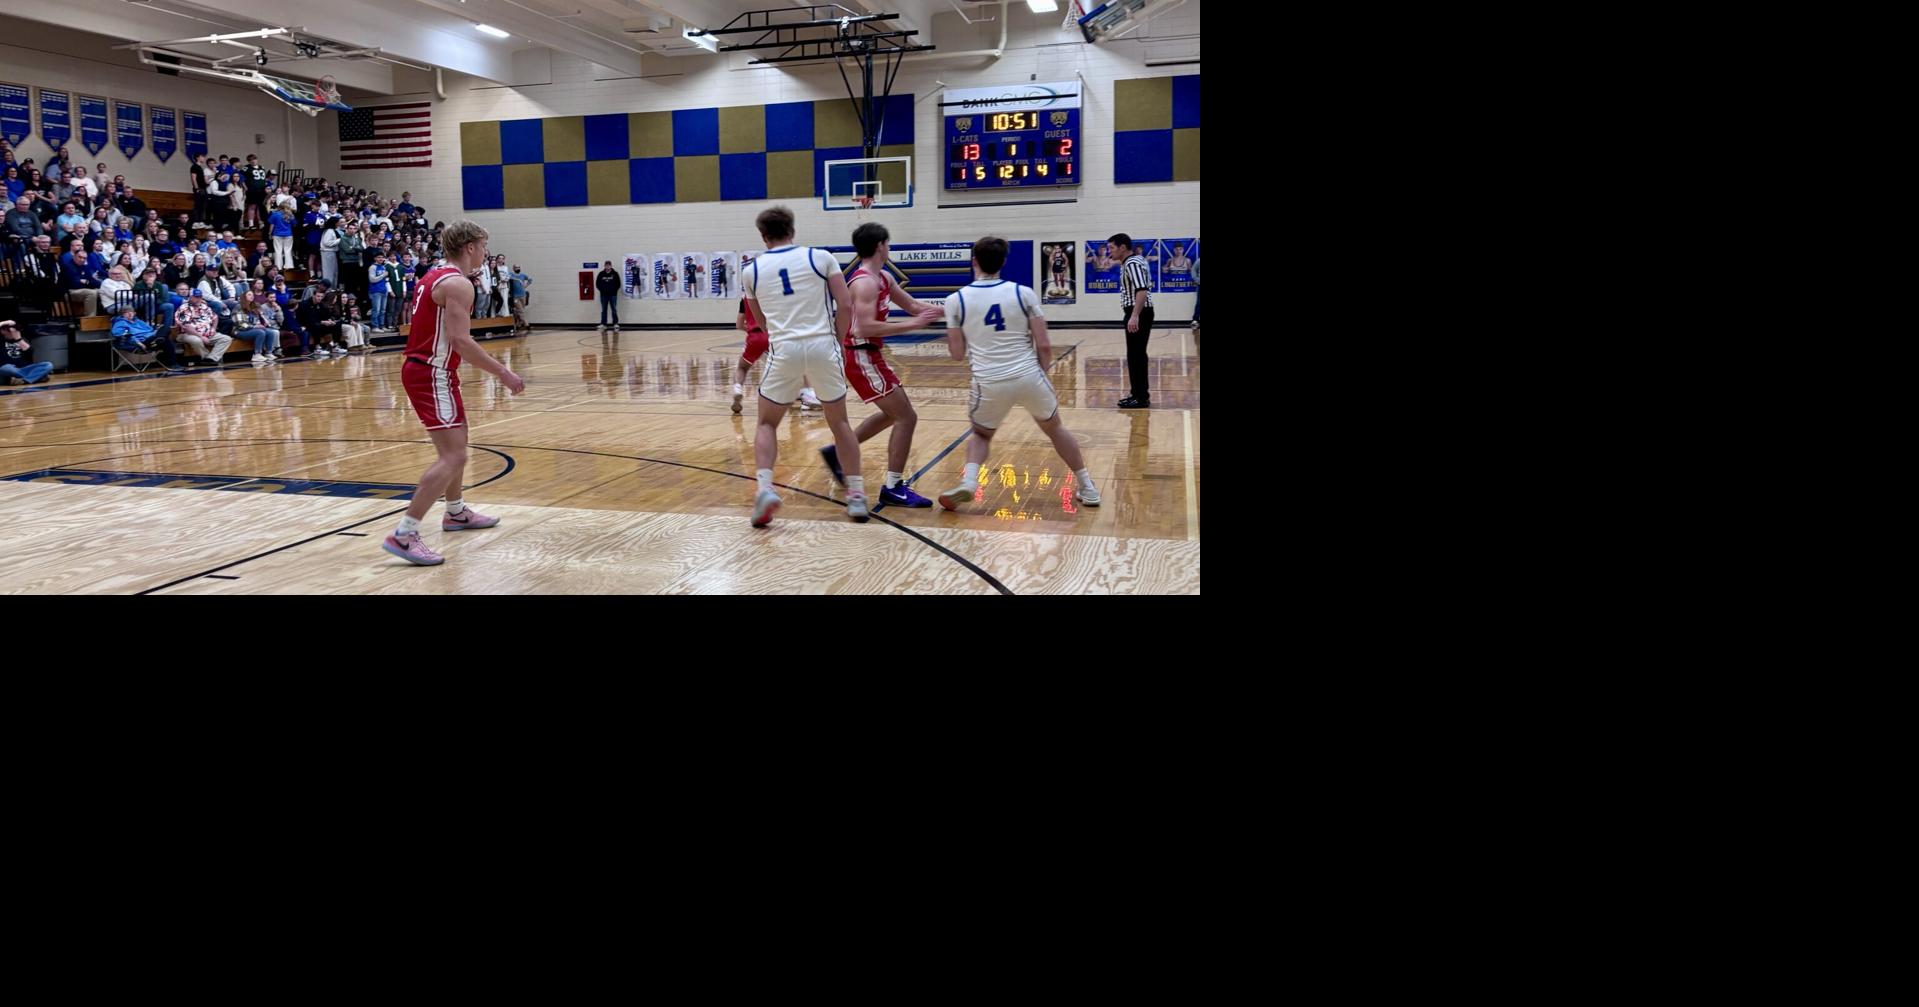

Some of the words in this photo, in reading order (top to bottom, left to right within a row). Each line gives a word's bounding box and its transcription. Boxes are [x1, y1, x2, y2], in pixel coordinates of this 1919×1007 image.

[992, 112, 1037, 130] 10:51
[952, 135, 979, 144] L-CATS
[1044, 129, 1071, 139] GUEST
[963, 144, 980, 161] 13
[1010, 144, 1017, 156] 1
[1059, 139, 1073, 156] 2
[252, 169, 266, 180] 93
[960, 168, 967, 180] 1
[975, 166, 986, 180] 5
[999, 165, 1015, 179] 12
[1021, 165, 1028, 177] 1
[1036, 164, 1048, 176] 4
[1066, 163, 1072, 175] 1
[900, 252, 927, 261] LAKE
[930, 251, 962, 260] MILLS
[394, 269, 401, 282] 1
[778, 268, 794, 296] 1
[984, 303, 1007, 332] 4
